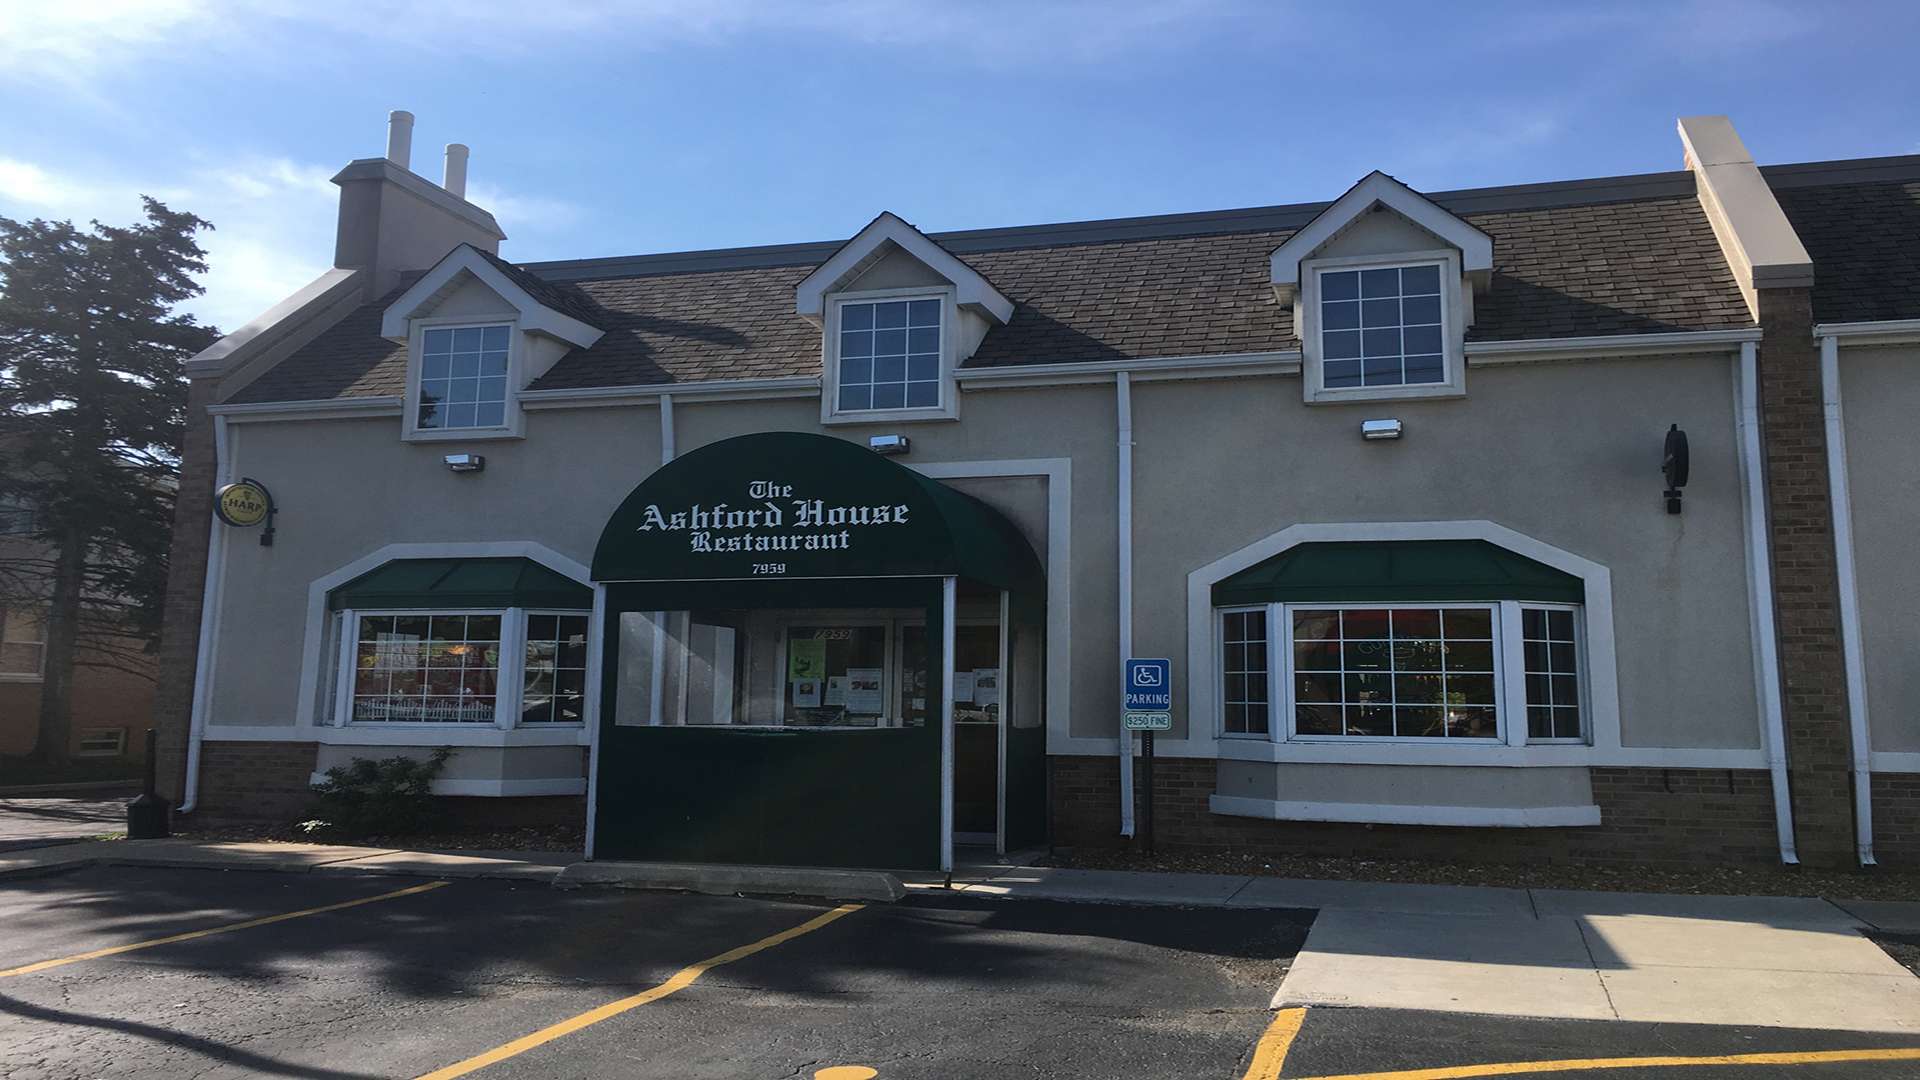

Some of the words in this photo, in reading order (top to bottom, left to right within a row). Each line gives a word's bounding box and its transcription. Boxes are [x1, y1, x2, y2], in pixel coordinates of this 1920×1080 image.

[749, 480, 793, 499] The
[229, 498, 262, 512] HARP
[637, 502, 782, 531] Ashford
[792, 499, 910, 526] House
[690, 530, 850, 552] Restaurant
[752, 563, 786, 574] 7959
[1126, 693, 1169, 704] PARKING
[1128, 716, 1148, 726] $250
[1150, 716, 1168, 726] FINE
